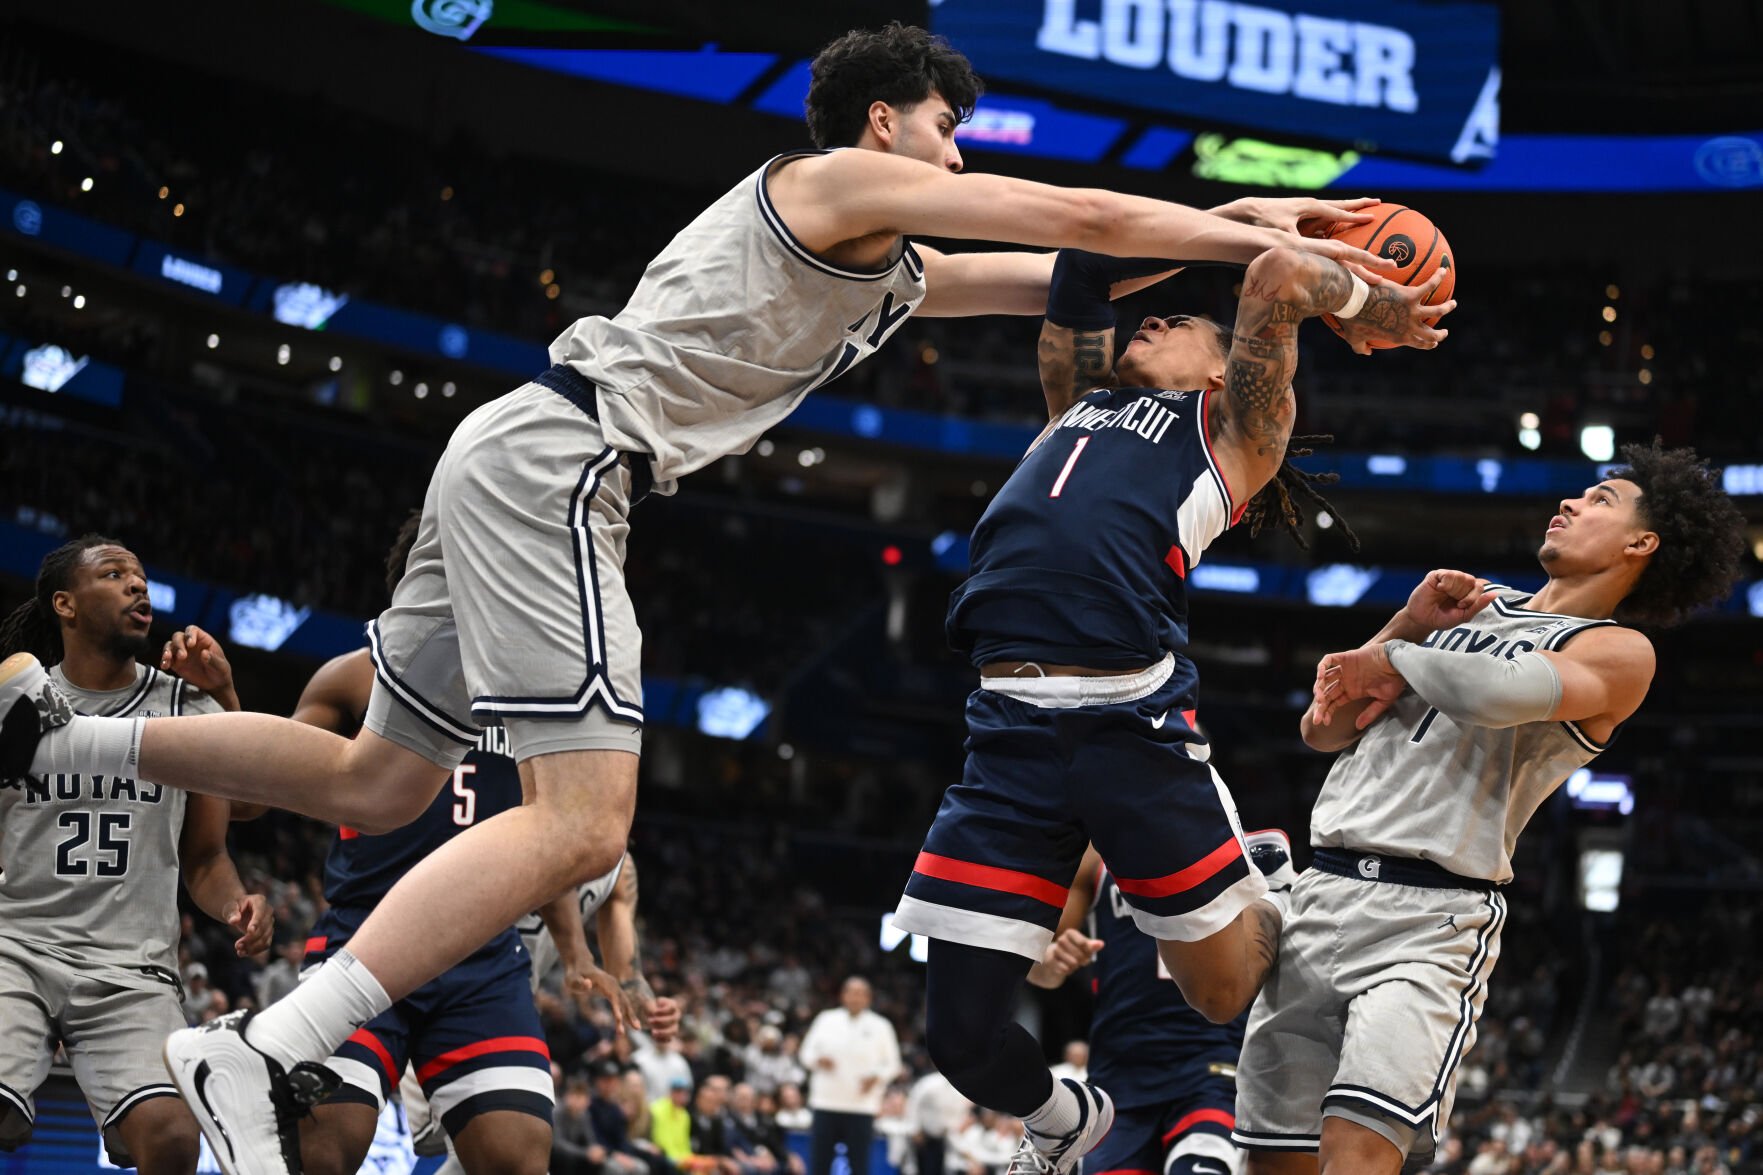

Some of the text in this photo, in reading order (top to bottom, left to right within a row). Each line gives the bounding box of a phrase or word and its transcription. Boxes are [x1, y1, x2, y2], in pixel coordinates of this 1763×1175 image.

[1036, 0, 1419, 113] LOUDER
[1049, 436, 1091, 498] 1
[452, 764, 477, 826] 5
[55, 810, 132, 877] 25
